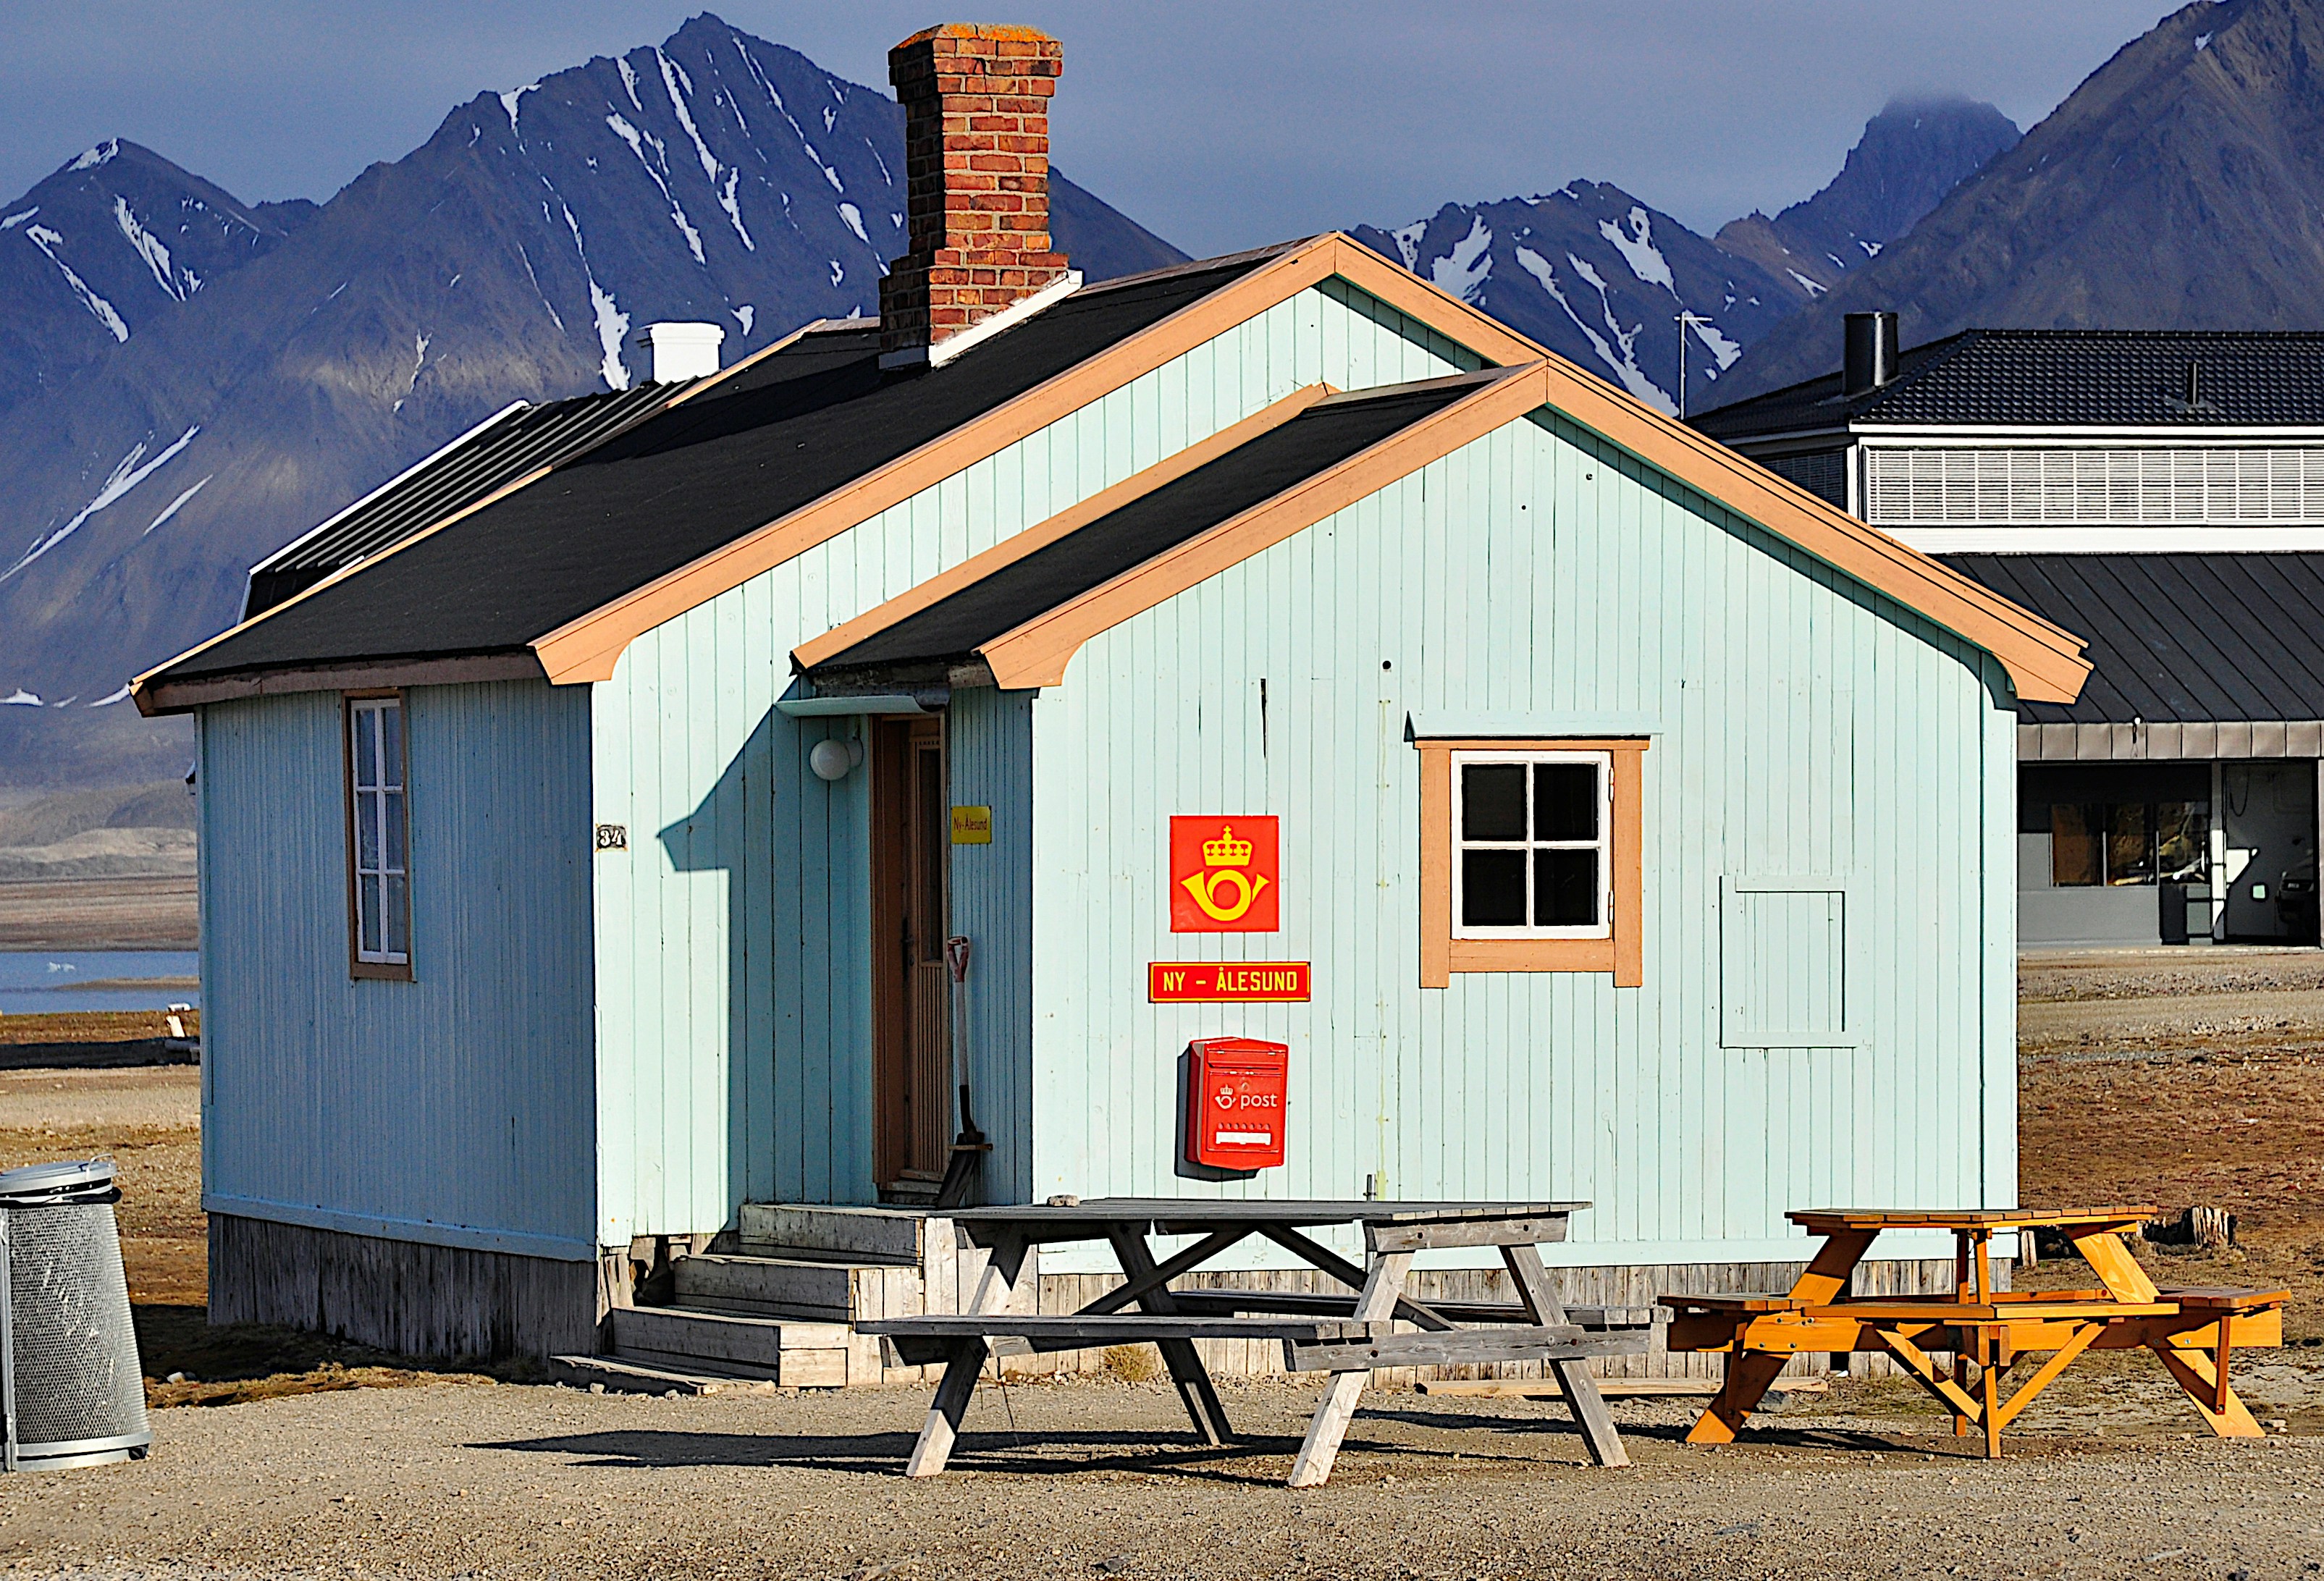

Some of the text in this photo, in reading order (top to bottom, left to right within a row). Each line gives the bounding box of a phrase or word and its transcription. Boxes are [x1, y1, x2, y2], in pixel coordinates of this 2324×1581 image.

[599, 830, 623, 846] 34
[1163, 971, 1186, 992] NY
[1216, 966, 1297, 992] ÅLESUND
[1239, 1093, 1279, 1110] post
